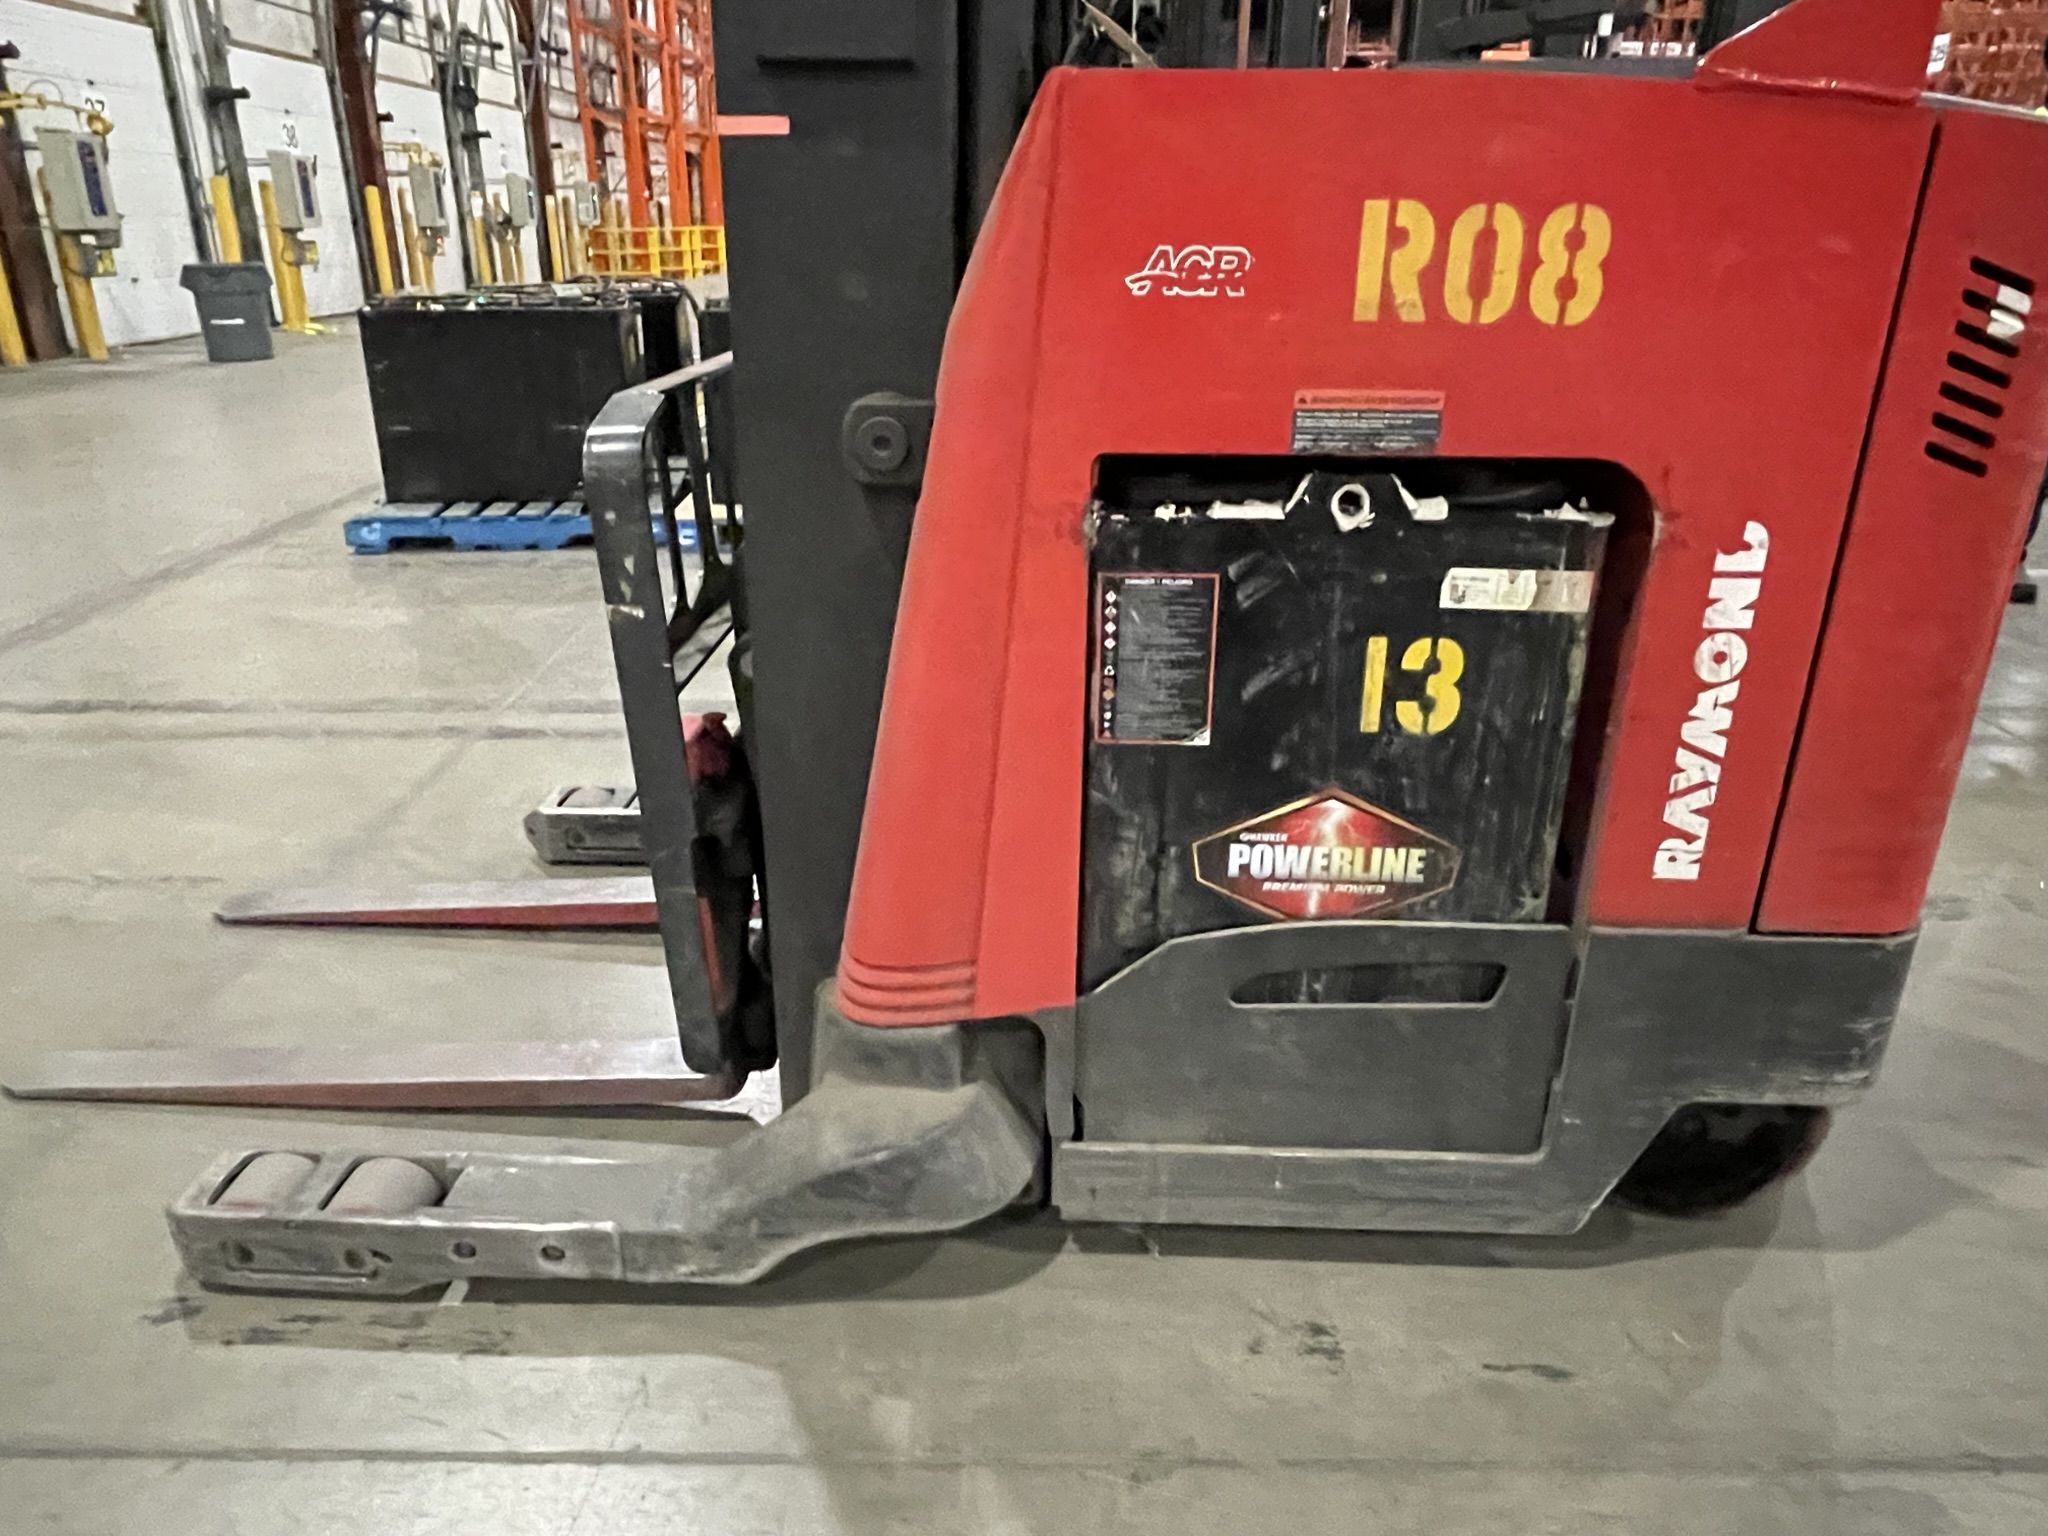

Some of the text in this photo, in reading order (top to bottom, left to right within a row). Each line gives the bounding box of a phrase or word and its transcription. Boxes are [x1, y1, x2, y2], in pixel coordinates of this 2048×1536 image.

[1353, 198, 1612, 327] R08
[1360, 635, 1464, 736] 13
[1227, 842, 1427, 883] POWERLINE
[1262, 881, 1386, 894] PREMIUM POWER
